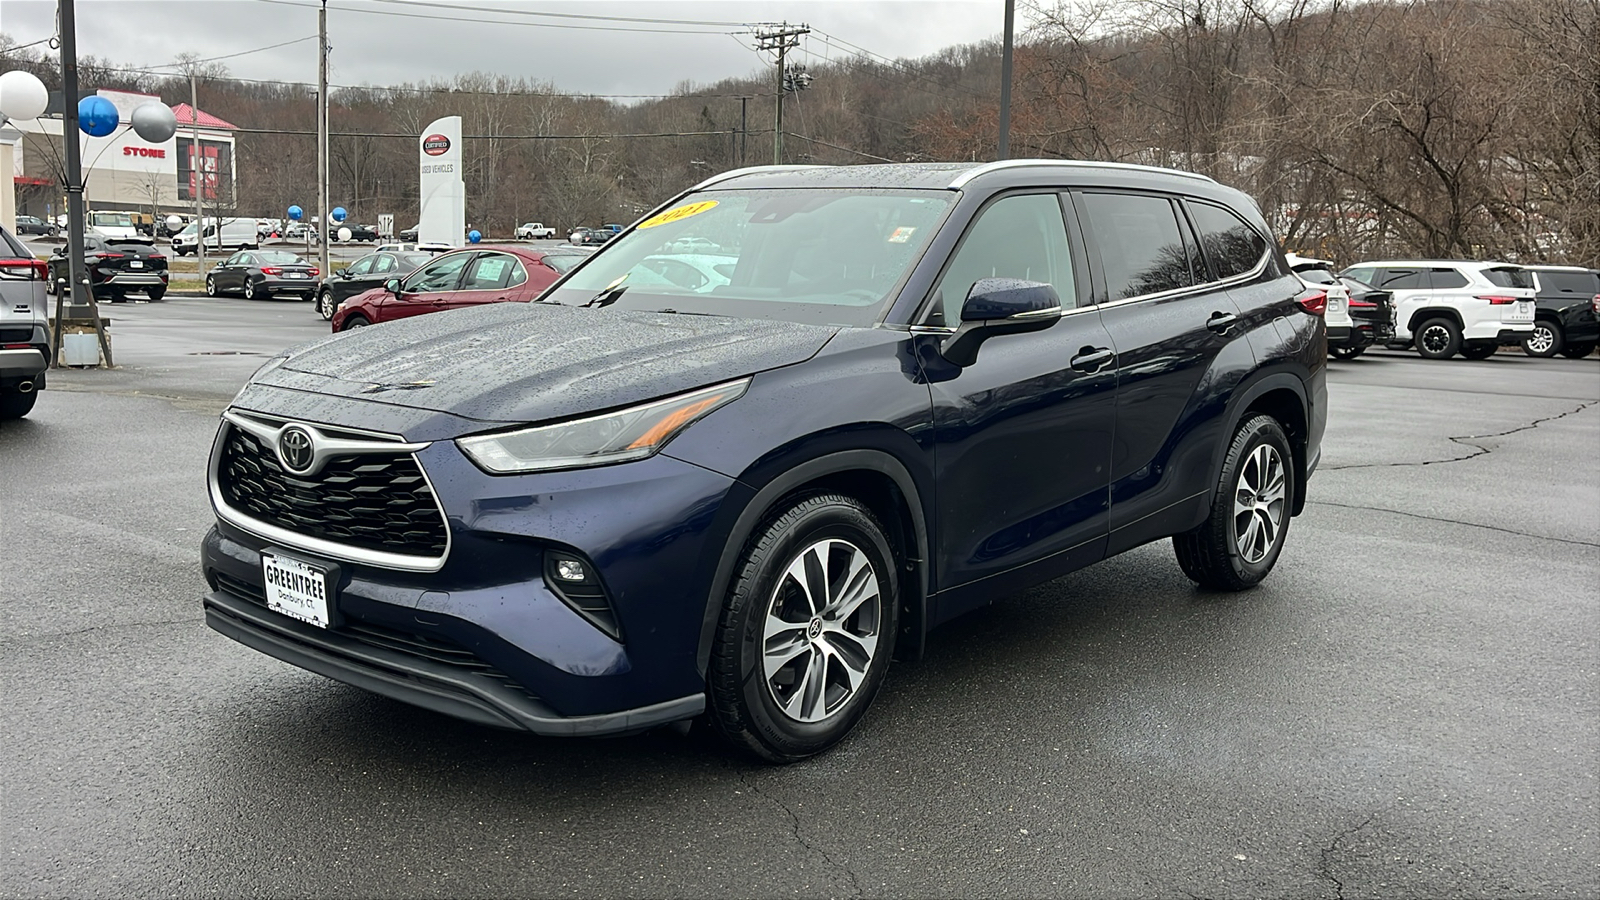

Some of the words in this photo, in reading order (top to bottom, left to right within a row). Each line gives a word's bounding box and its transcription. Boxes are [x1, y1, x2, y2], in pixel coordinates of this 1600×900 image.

[123, 147, 165, 158] STONE
[422, 165, 431, 174] USED
[432, 164, 453, 174] VEHICLES
[266, 564, 324, 601] GREENTREE
